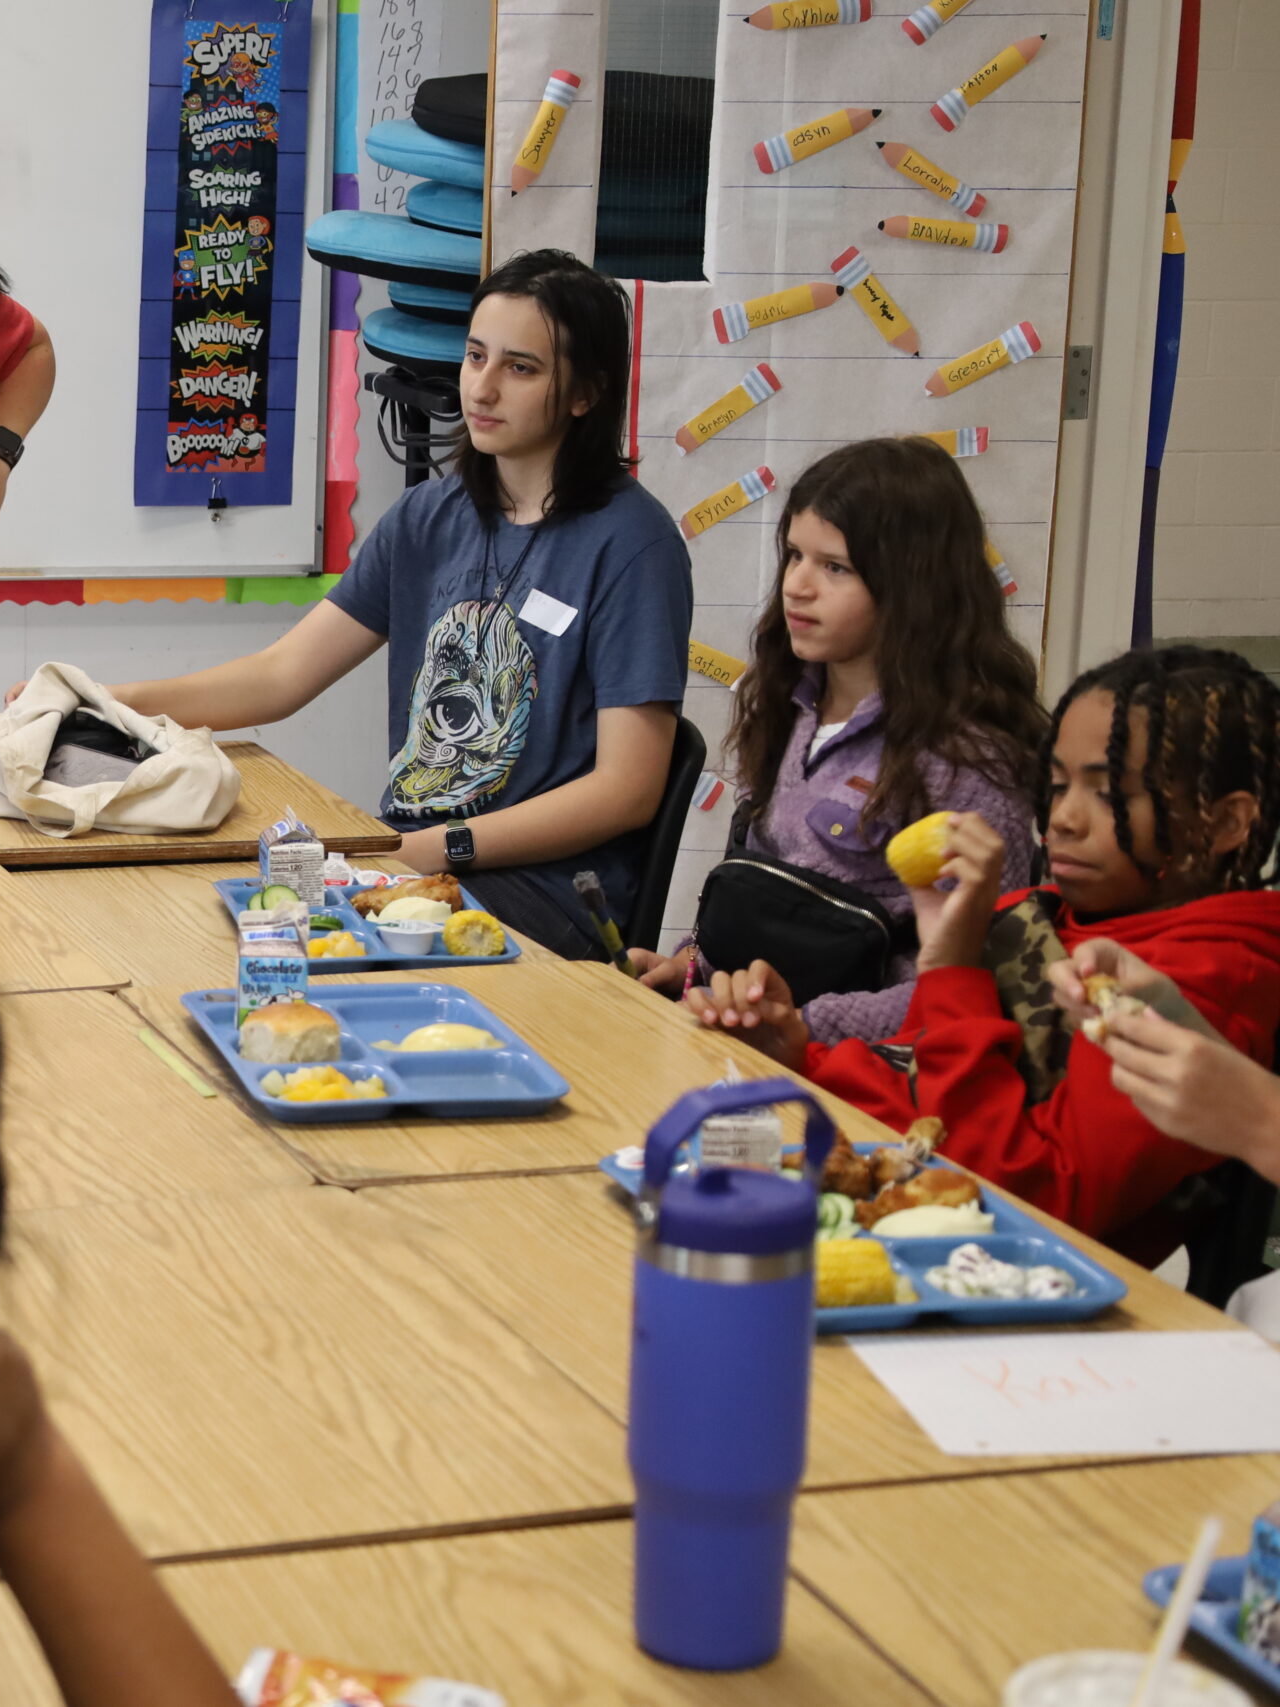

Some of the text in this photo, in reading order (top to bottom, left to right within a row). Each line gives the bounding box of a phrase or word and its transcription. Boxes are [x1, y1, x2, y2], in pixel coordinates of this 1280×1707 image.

[380, 22, 405, 44] 16
[193, 32, 270, 75] SUPER!
[376, 69, 421, 101] 12 6
[188, 105, 255, 134] AMAZING
[522, 109, 557, 165] Sawyer
[188, 168, 262, 189] SOARING
[199, 188, 252, 208] HIGH!
[198, 229, 246, 249] READY
[214, 247, 232, 260] TO
[200, 259, 255, 289] FLY!
[174, 320, 264, 353] WARNING!
[178, 371, 258, 408] DANGER!
[694, 495, 736, 529] Fynn
